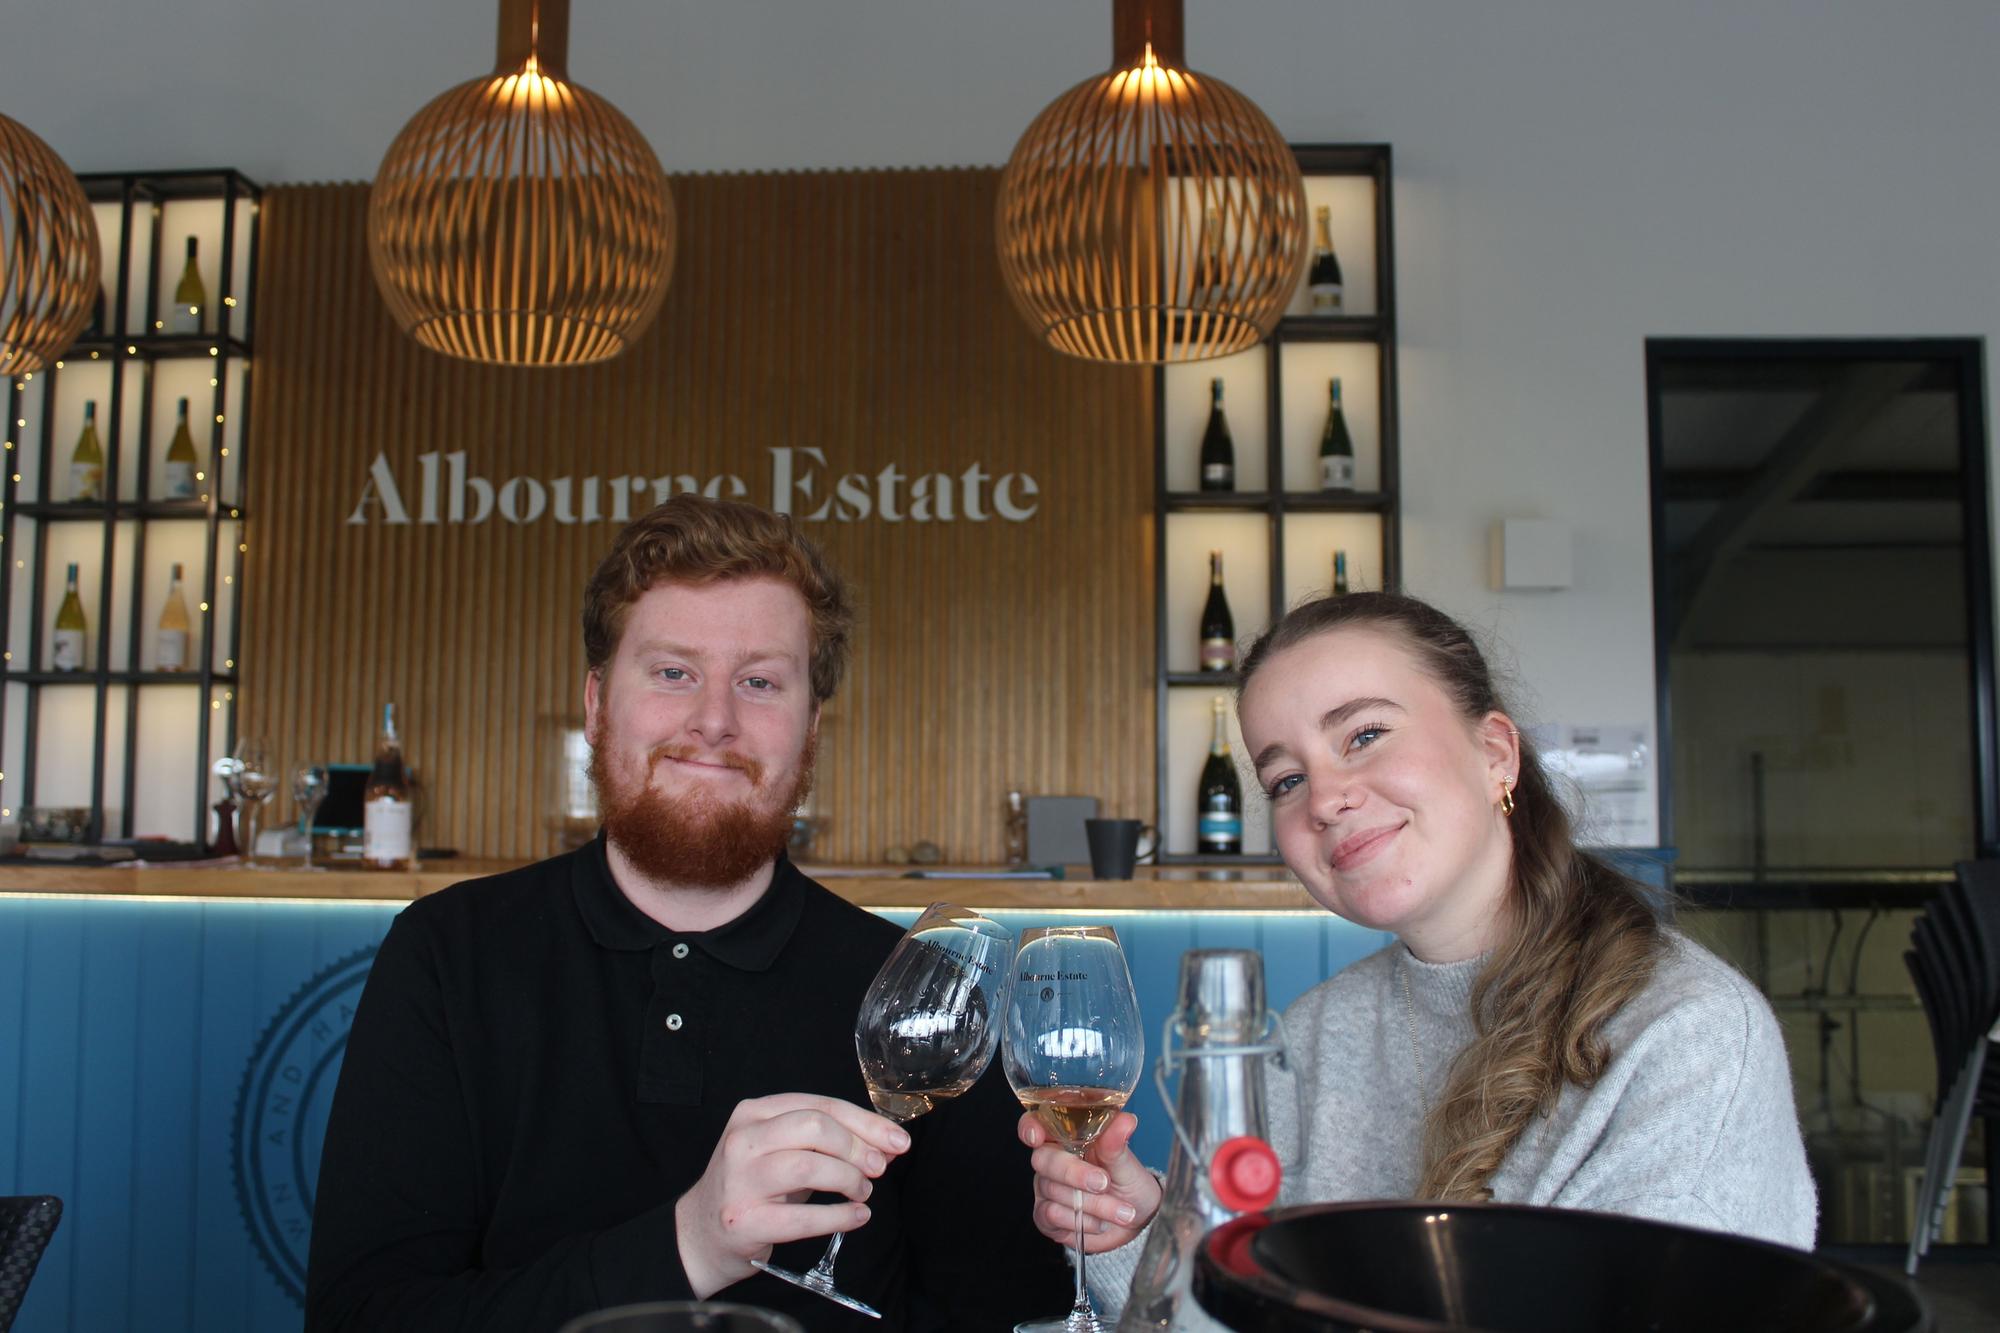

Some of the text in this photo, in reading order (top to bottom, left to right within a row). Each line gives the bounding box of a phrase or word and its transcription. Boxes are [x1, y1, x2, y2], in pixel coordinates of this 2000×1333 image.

[767, 446, 1039, 523] Estate
[1056, 970, 1088, 981] Estate
[268, 1065, 303, 1146] AND
